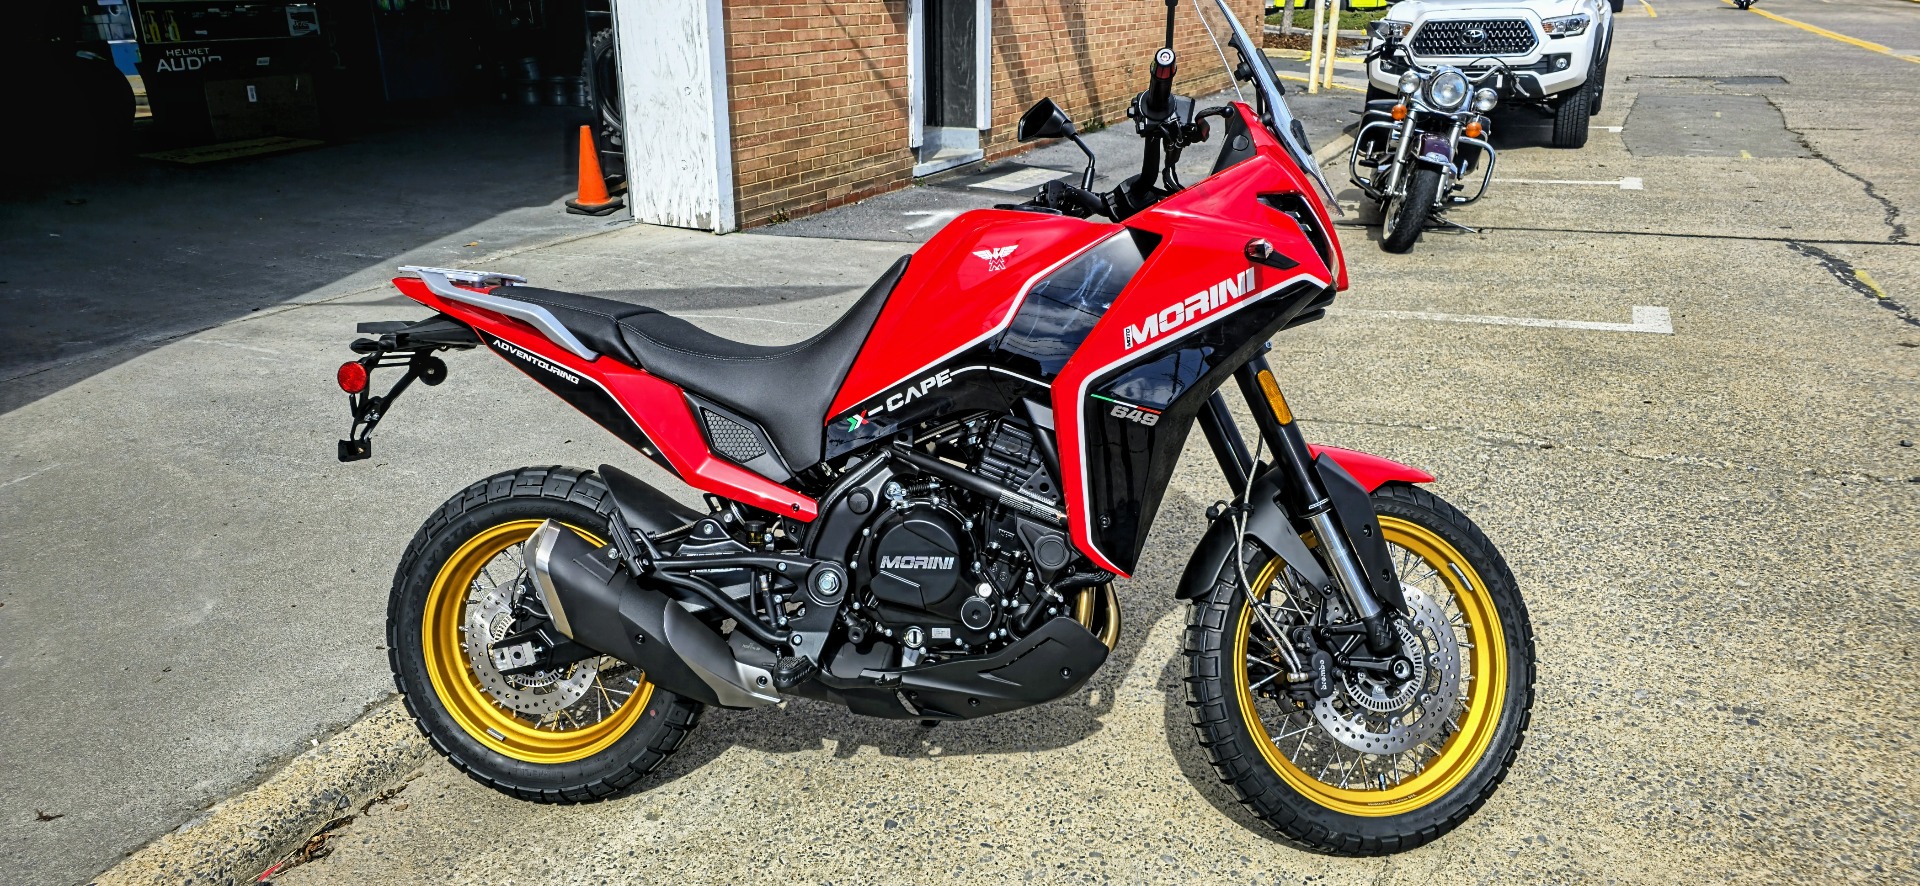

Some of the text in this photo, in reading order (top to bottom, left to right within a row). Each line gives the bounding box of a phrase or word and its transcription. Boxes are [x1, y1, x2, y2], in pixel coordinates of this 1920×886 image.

[166, 48, 209, 56] HELMET
[1131, 267, 1255, 345] MORINI
[493, 340, 580, 385] ADVENTOURING
[1110, 405, 1160, 427] 649
[1373, 502, 1458, 541] CORPION
[880, 555, 955, 570] MORINI
[1319, 659, 1327, 690] brembo
